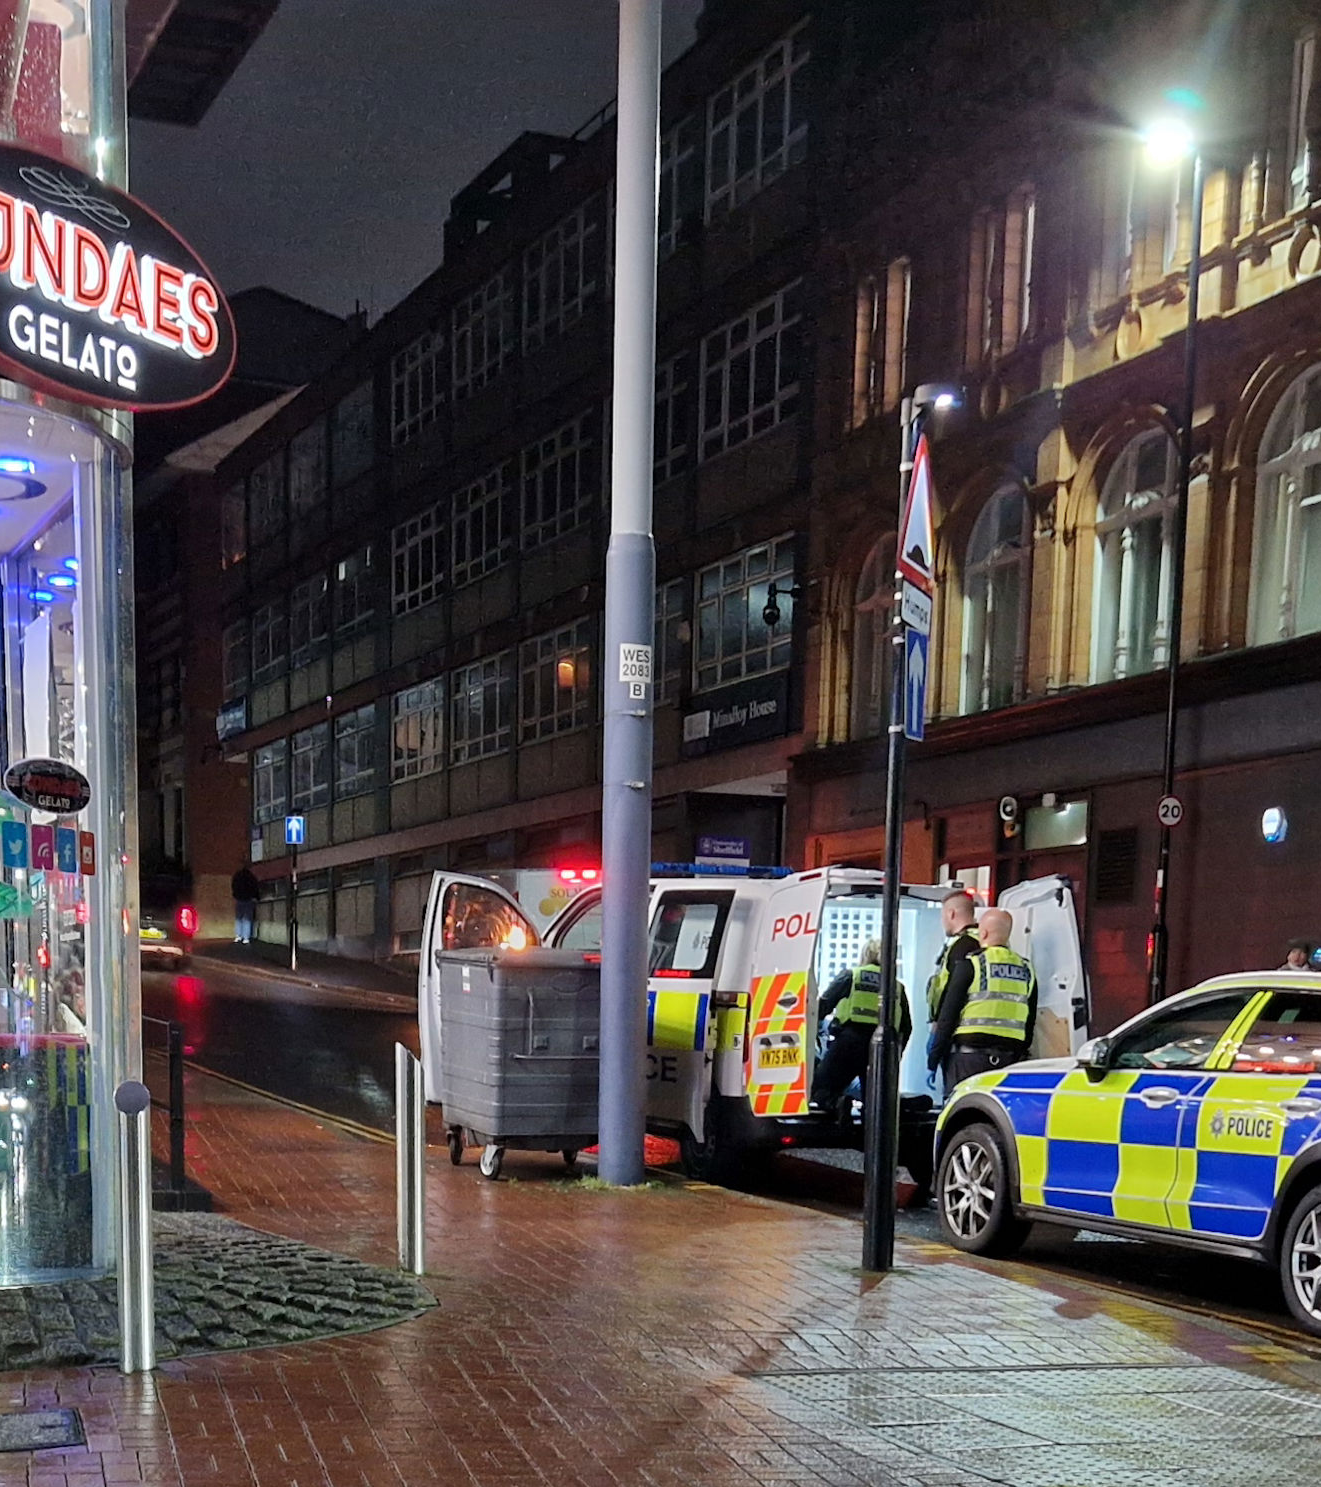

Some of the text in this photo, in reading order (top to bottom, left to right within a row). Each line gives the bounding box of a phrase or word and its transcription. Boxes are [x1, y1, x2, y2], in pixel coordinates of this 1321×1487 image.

[7, 303, 138, 393] GELATO
[623, 648, 650, 664] WES
[633, 683, 642, 696] B
[749, 700, 777, 719] House
[38, 795, 70, 809] GELATO
[1161, 804, 1181, 818] 20
[991, 964, 1028, 981] POLICE
[1227, 1117, 1273, 1139] POLICE
